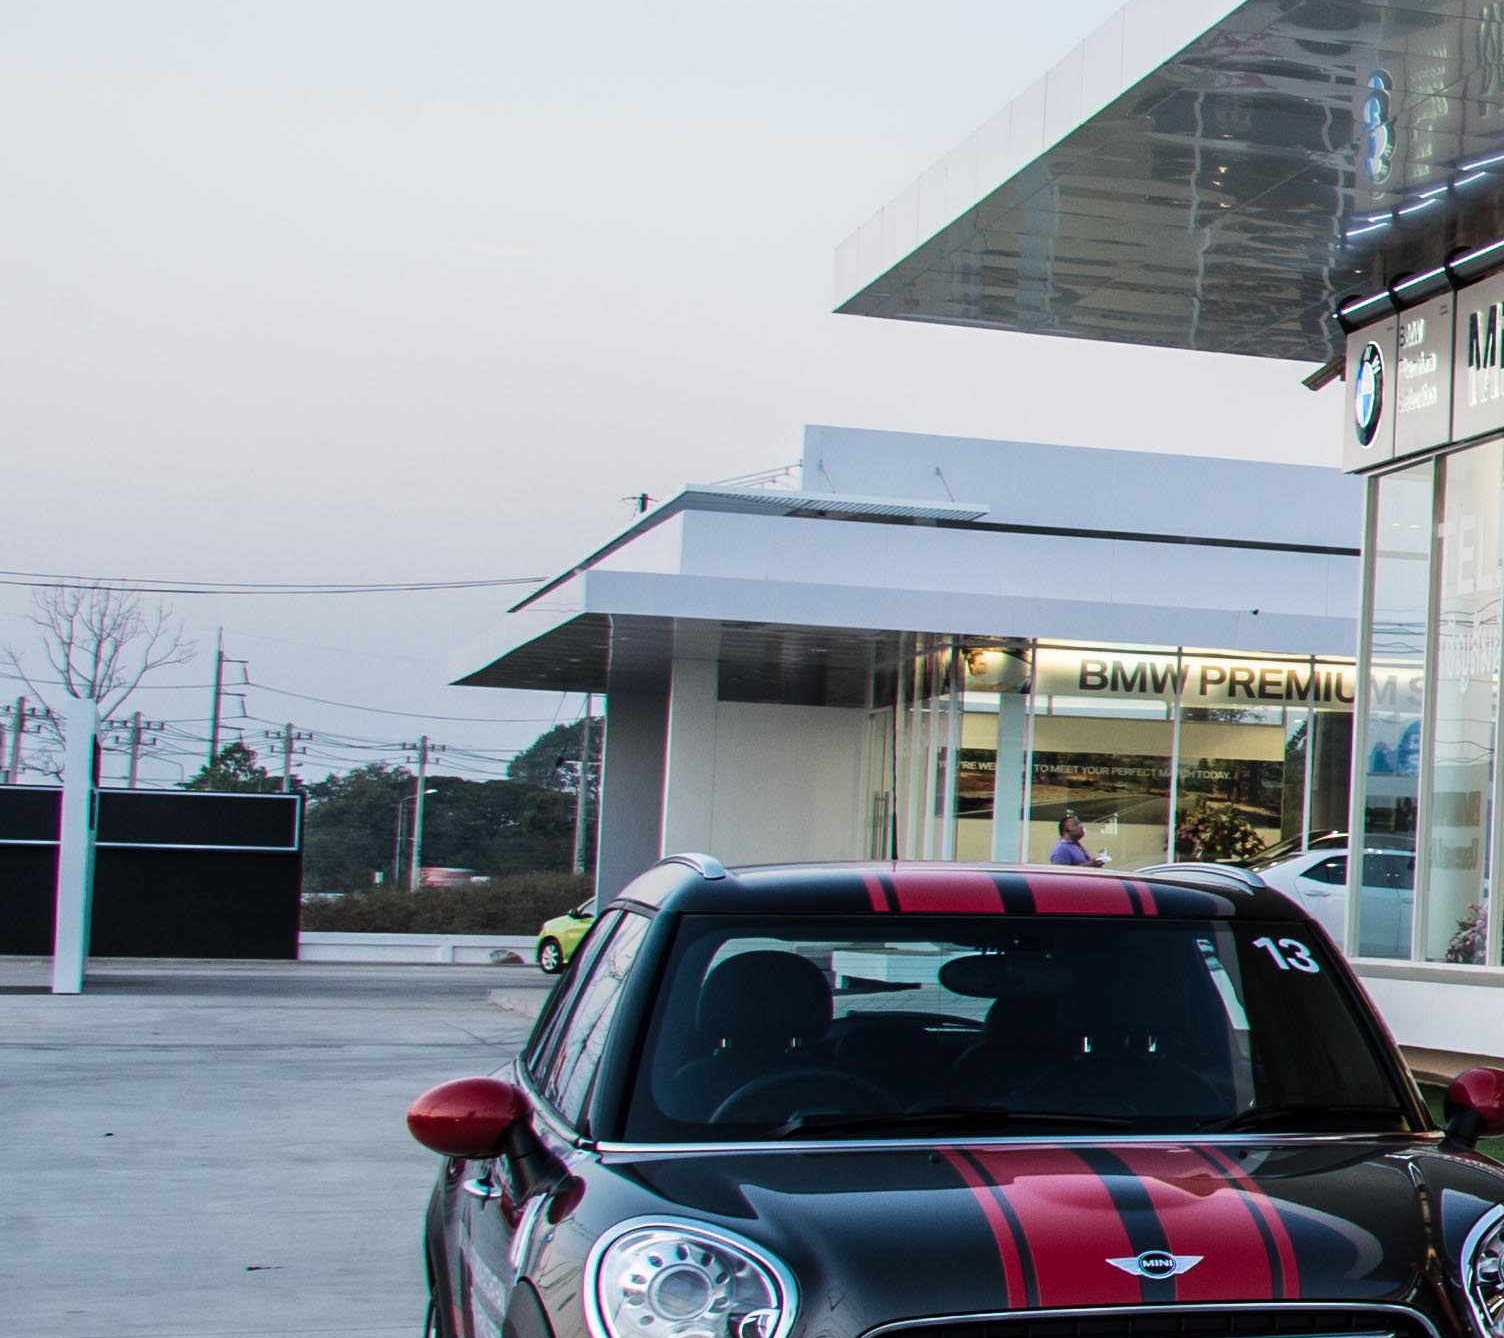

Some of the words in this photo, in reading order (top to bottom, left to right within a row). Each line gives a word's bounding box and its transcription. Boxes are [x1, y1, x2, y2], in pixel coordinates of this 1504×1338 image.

[1079, 659, 1189, 694] BMW
[1034, 764, 1049, 773] TO
[1050, 764, 1080, 773] MEET
[1081, 766, 1109, 775] YOUR
[1111, 767, 1157, 777] PERFECT
[1253, 936, 1320, 974] 13
[1142, 1259, 1173, 1267] MINI
